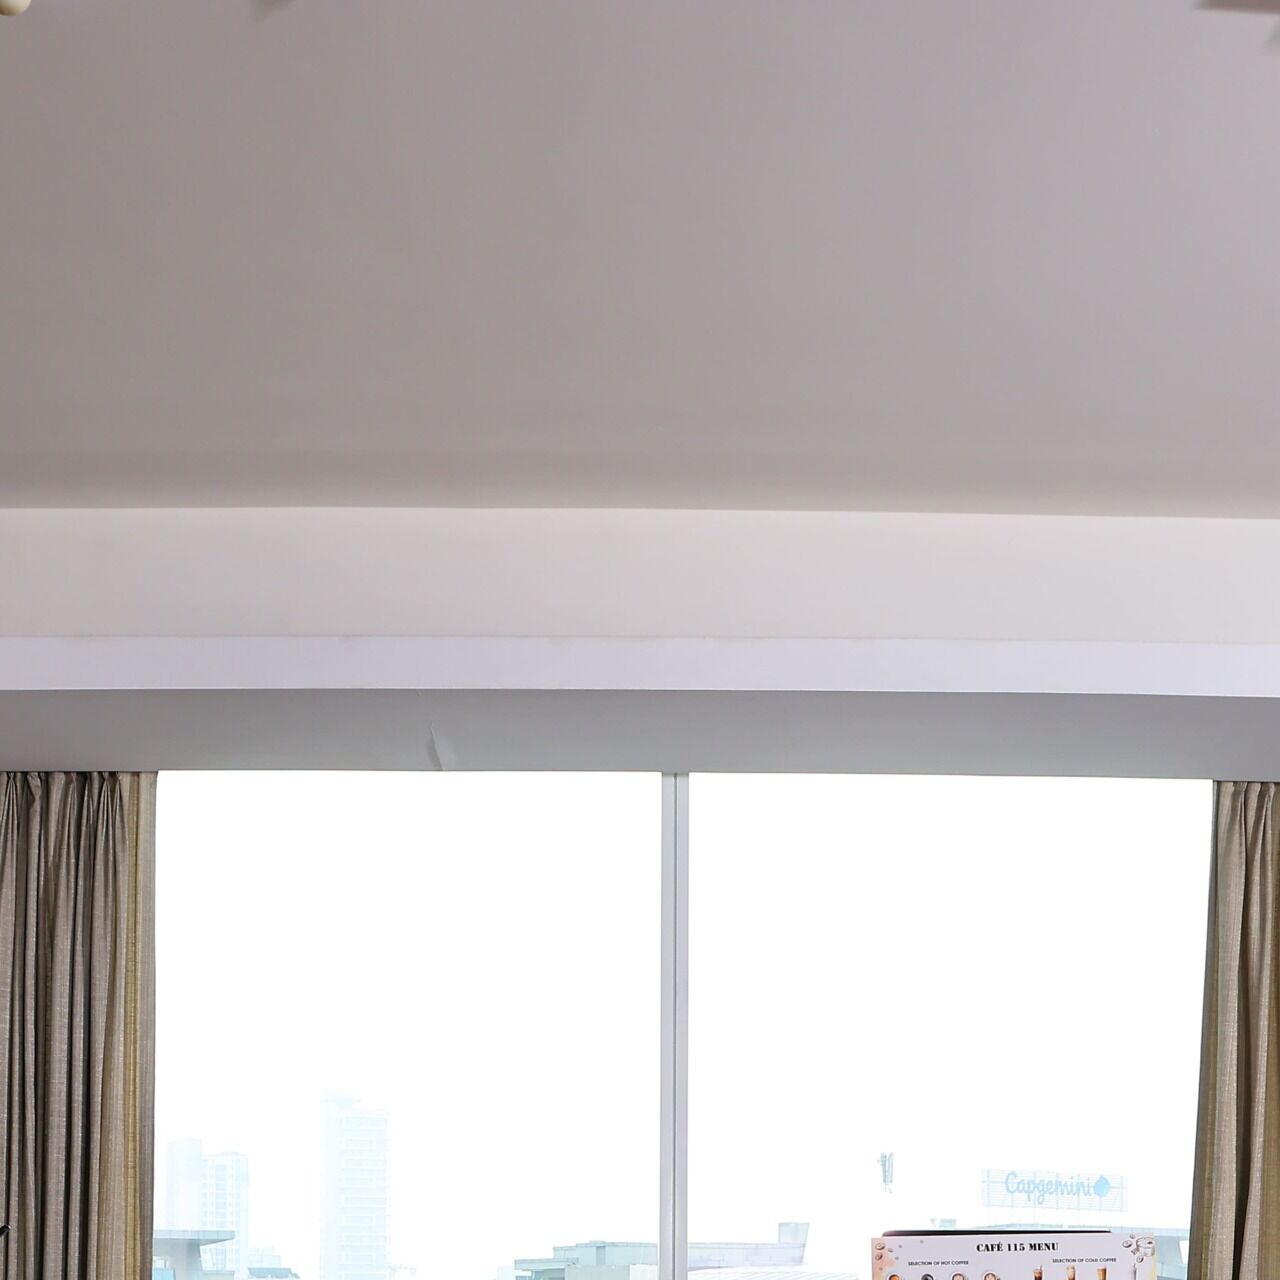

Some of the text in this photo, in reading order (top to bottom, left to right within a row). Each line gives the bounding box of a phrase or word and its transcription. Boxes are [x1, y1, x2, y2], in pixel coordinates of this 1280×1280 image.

[1004, 1171, 1092, 1205] Capgemini
[976, 1241, 1059, 1252] CAFÉ 115 MENU
